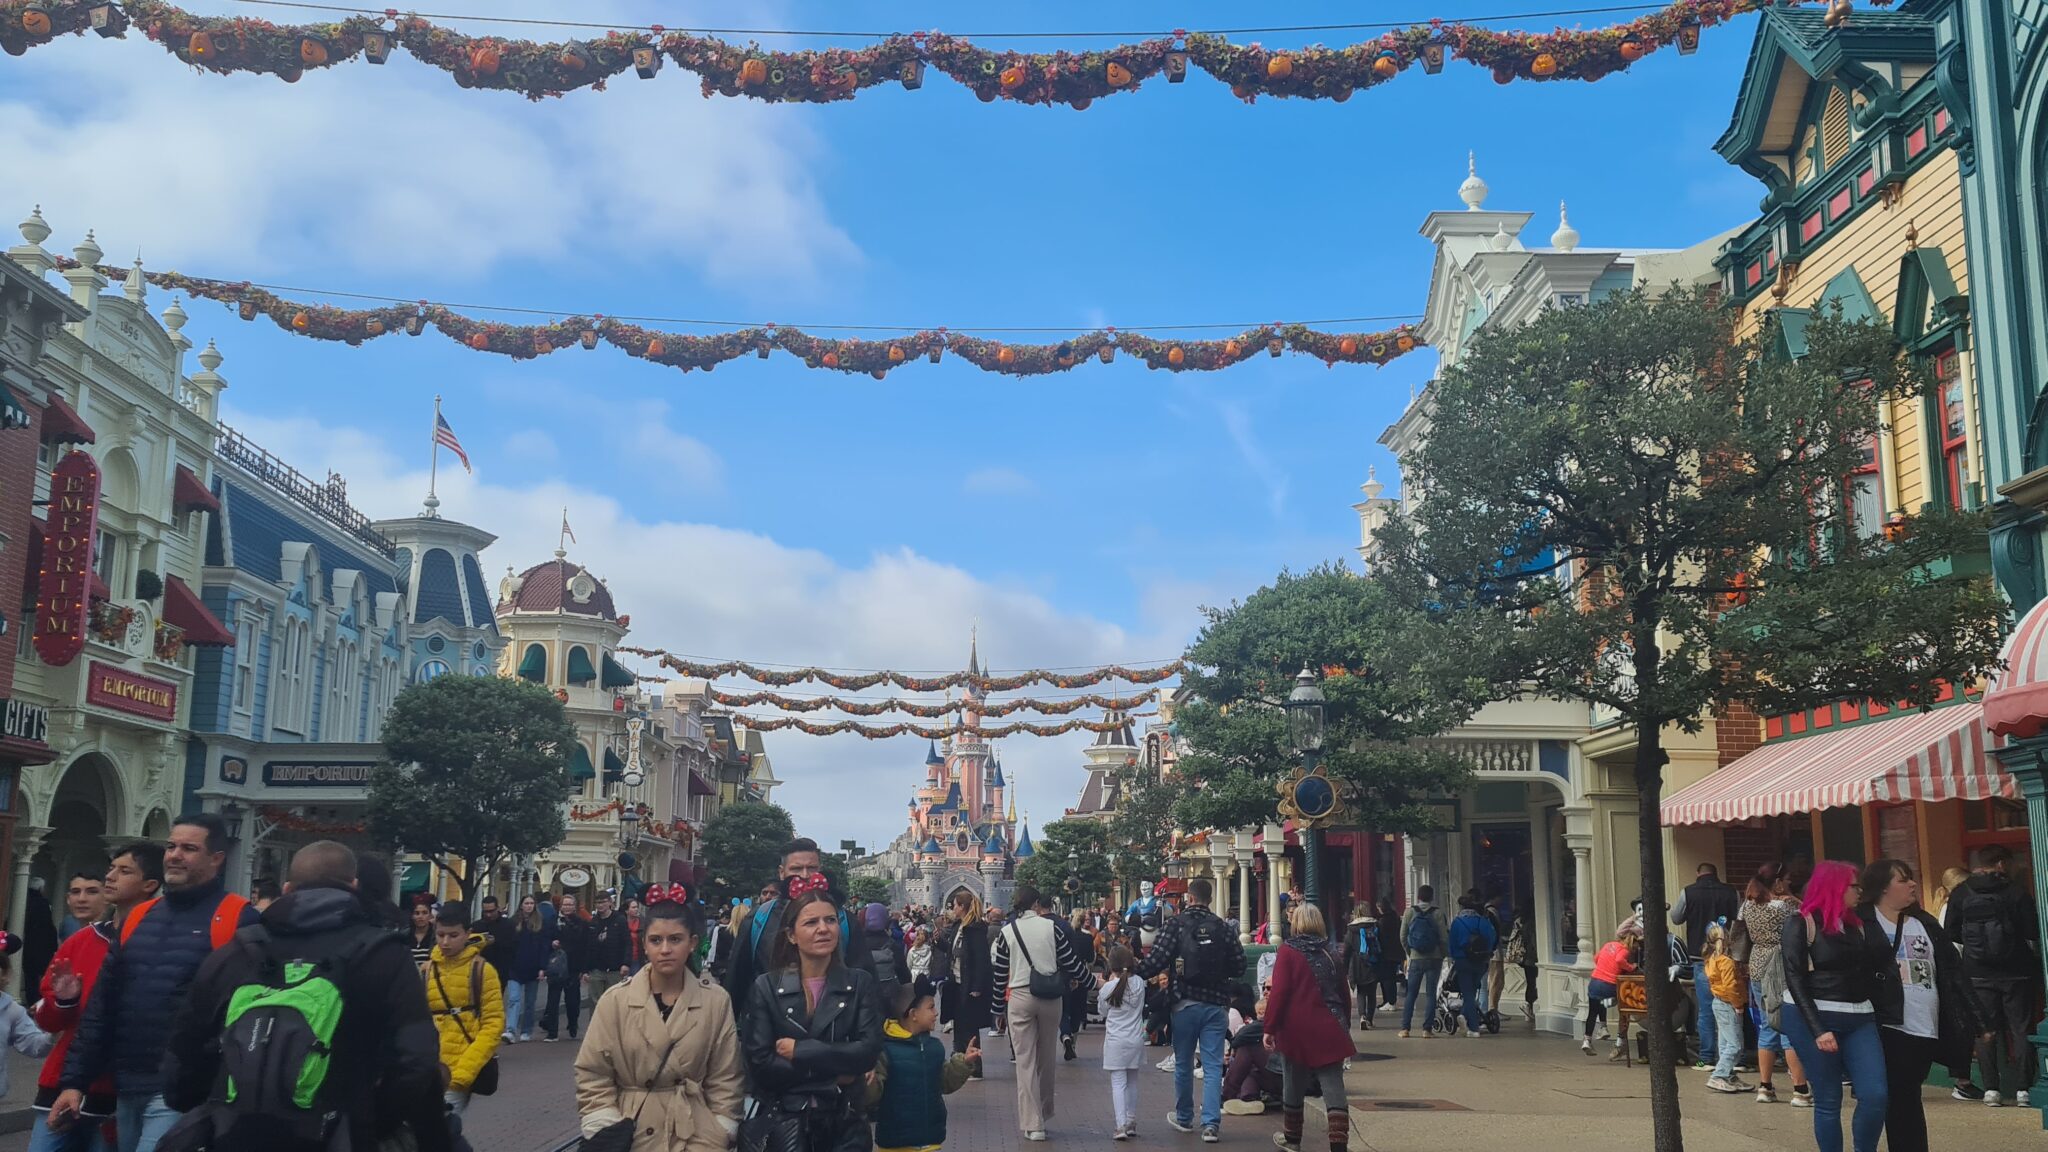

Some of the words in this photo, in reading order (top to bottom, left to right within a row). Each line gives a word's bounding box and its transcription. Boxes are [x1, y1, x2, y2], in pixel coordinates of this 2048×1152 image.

[47, 475, 85, 634] EMPORIUM
[103, 676, 169, 707] EMPORIUM
[4, 699, 49, 743] GIFTS
